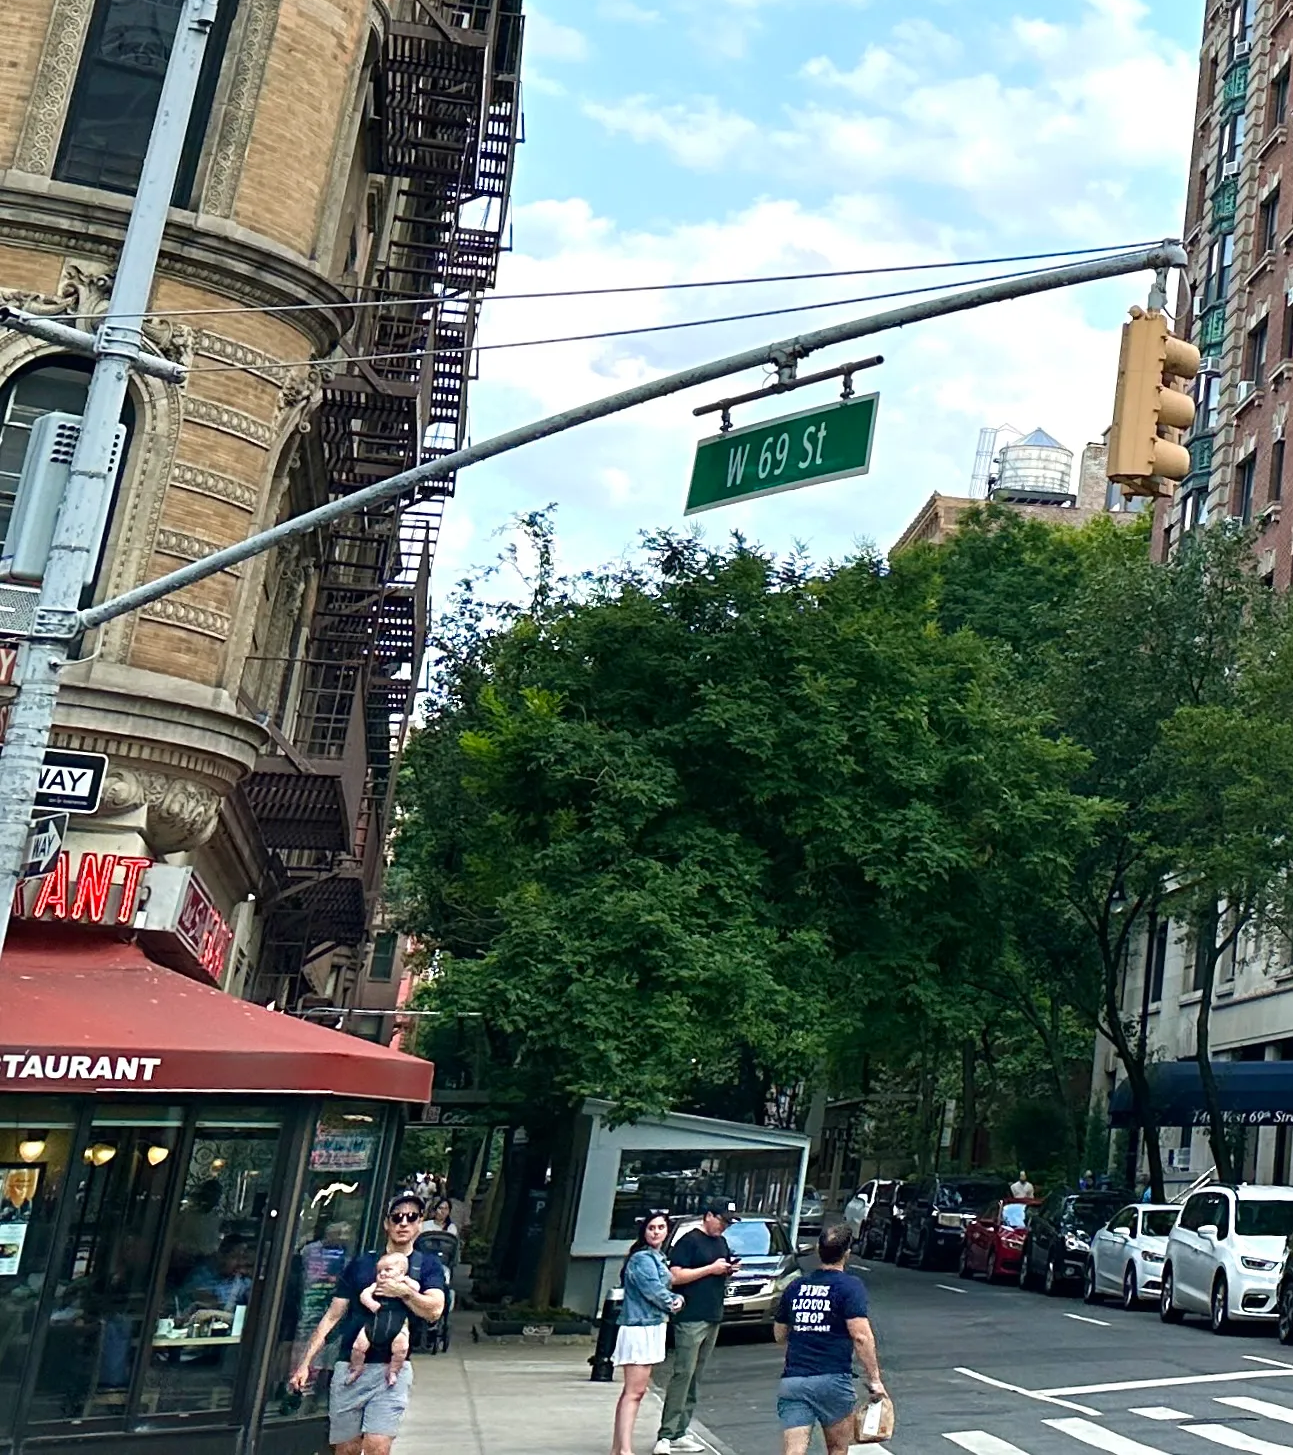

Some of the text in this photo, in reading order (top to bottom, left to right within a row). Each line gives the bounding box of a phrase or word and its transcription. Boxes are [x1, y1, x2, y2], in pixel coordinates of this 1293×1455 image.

[726, 421, 827, 488] W 69 St
[32, 834, 57, 860] WAY
[0, 1054, 161, 1081] TAURANT
[792, 1298, 831, 1312] LIQUOR
[795, 1311, 825, 1324] SHOP
